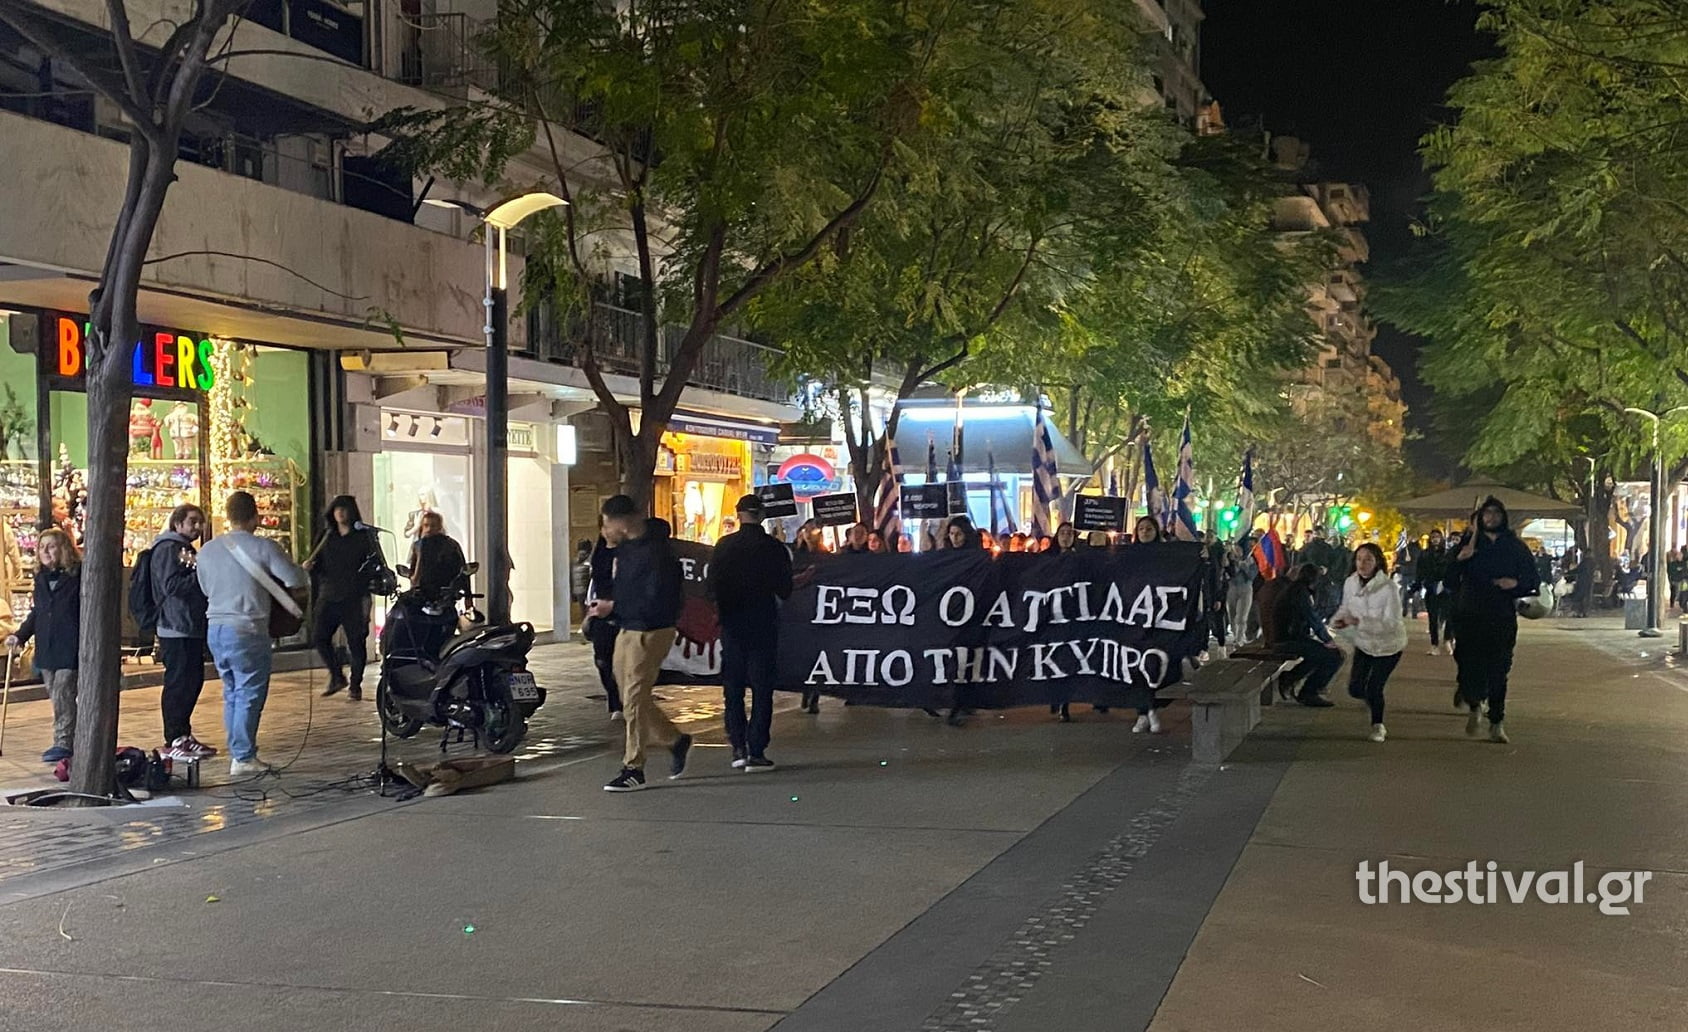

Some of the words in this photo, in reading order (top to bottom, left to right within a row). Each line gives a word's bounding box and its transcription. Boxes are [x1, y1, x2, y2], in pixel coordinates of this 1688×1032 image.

[58, 316, 214, 390] BLERS
[811, 584, 916, 625] ΕΞΩ
[939, 586, 975, 627] Ο
[982, 581, 1188, 632] ΑΤΤΙΛΑΣ
[804, 649, 914, 687] ΑΠΟ
[923, 646, 1018, 685] ΤΗΝ
[1027, 638, 1169, 689] ΚΥΠΡΟ
